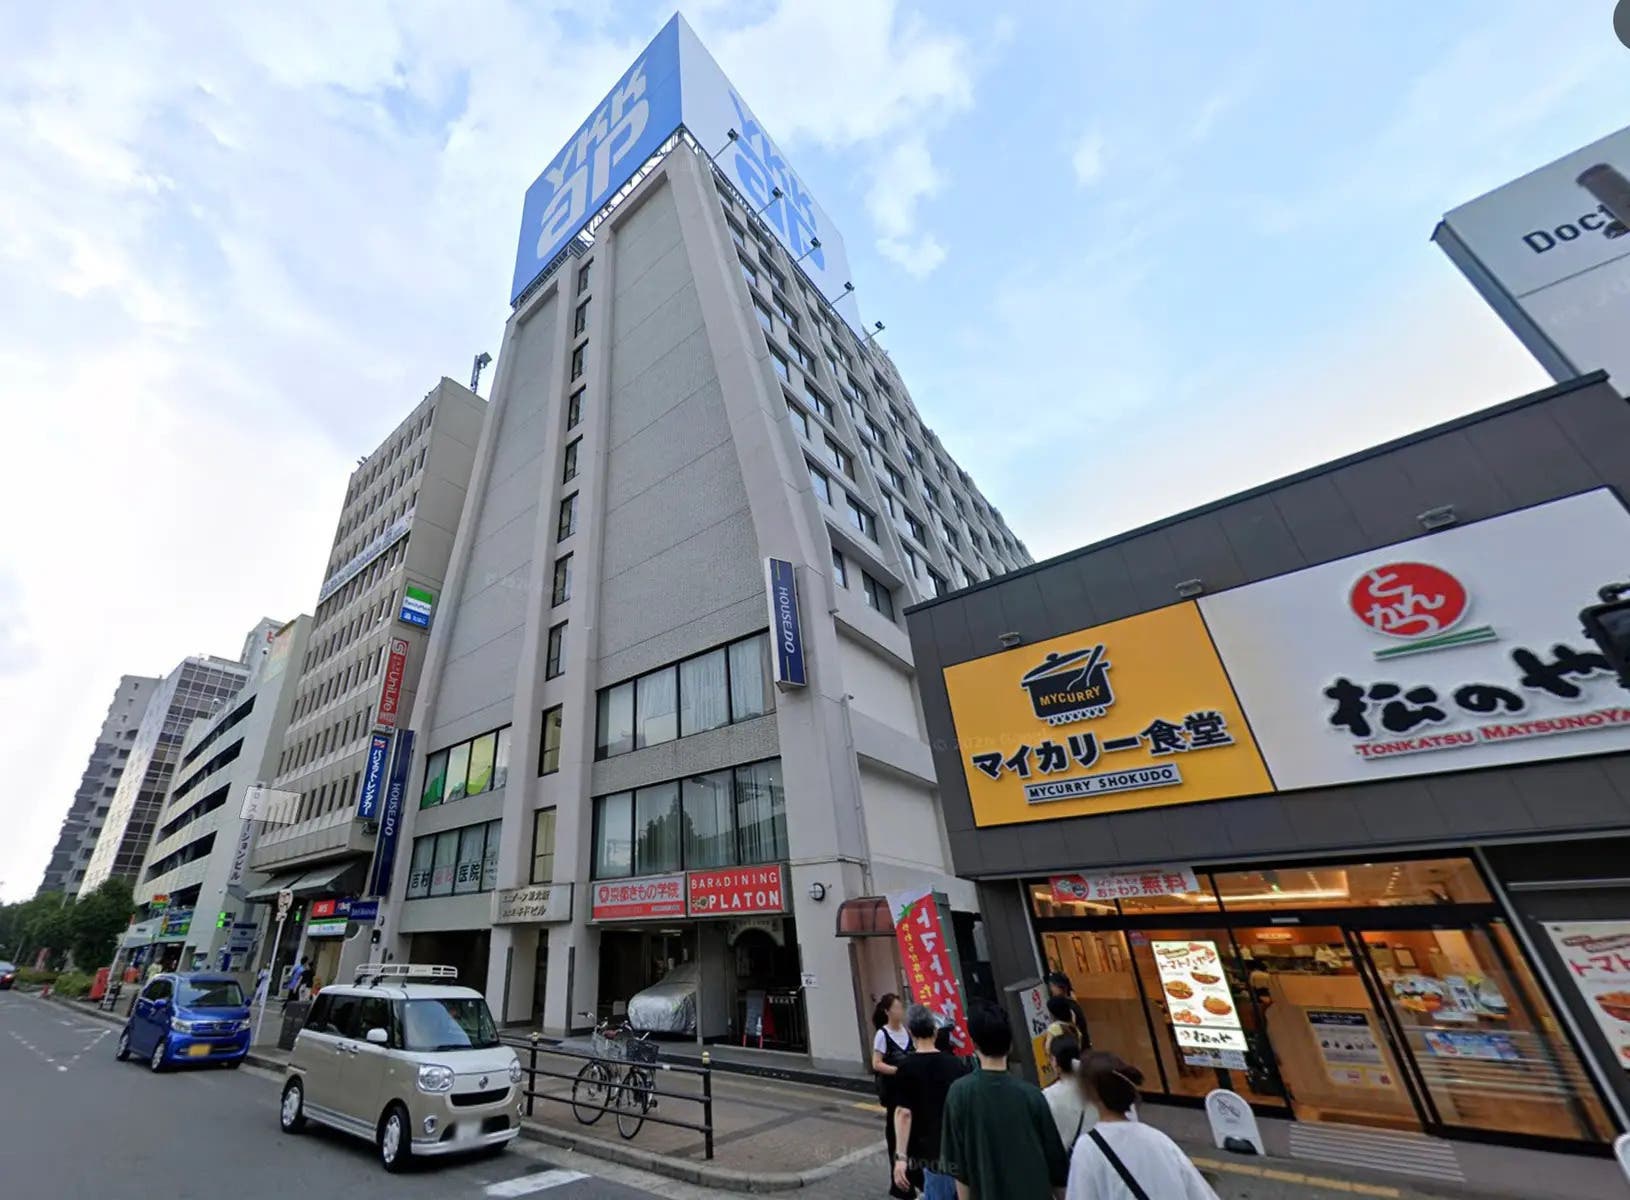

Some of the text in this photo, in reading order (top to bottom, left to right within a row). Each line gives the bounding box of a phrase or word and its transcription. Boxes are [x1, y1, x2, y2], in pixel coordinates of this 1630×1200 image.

[543, 59, 648, 193] YKK
[536, 98, 651, 260] ap
[1365, 569, 1446, 632] とんかつ
[1039, 685, 1101, 706] MYCURRY
[1324, 644, 1617, 738] 松のや
[972, 711, 1235, 779] マイカリー食堂
[1357, 731, 1474, 757] TONKATSU
[1029, 768, 1173, 798] MYCURRY SHOKUDO
[709, 890, 780, 910] PLATON
